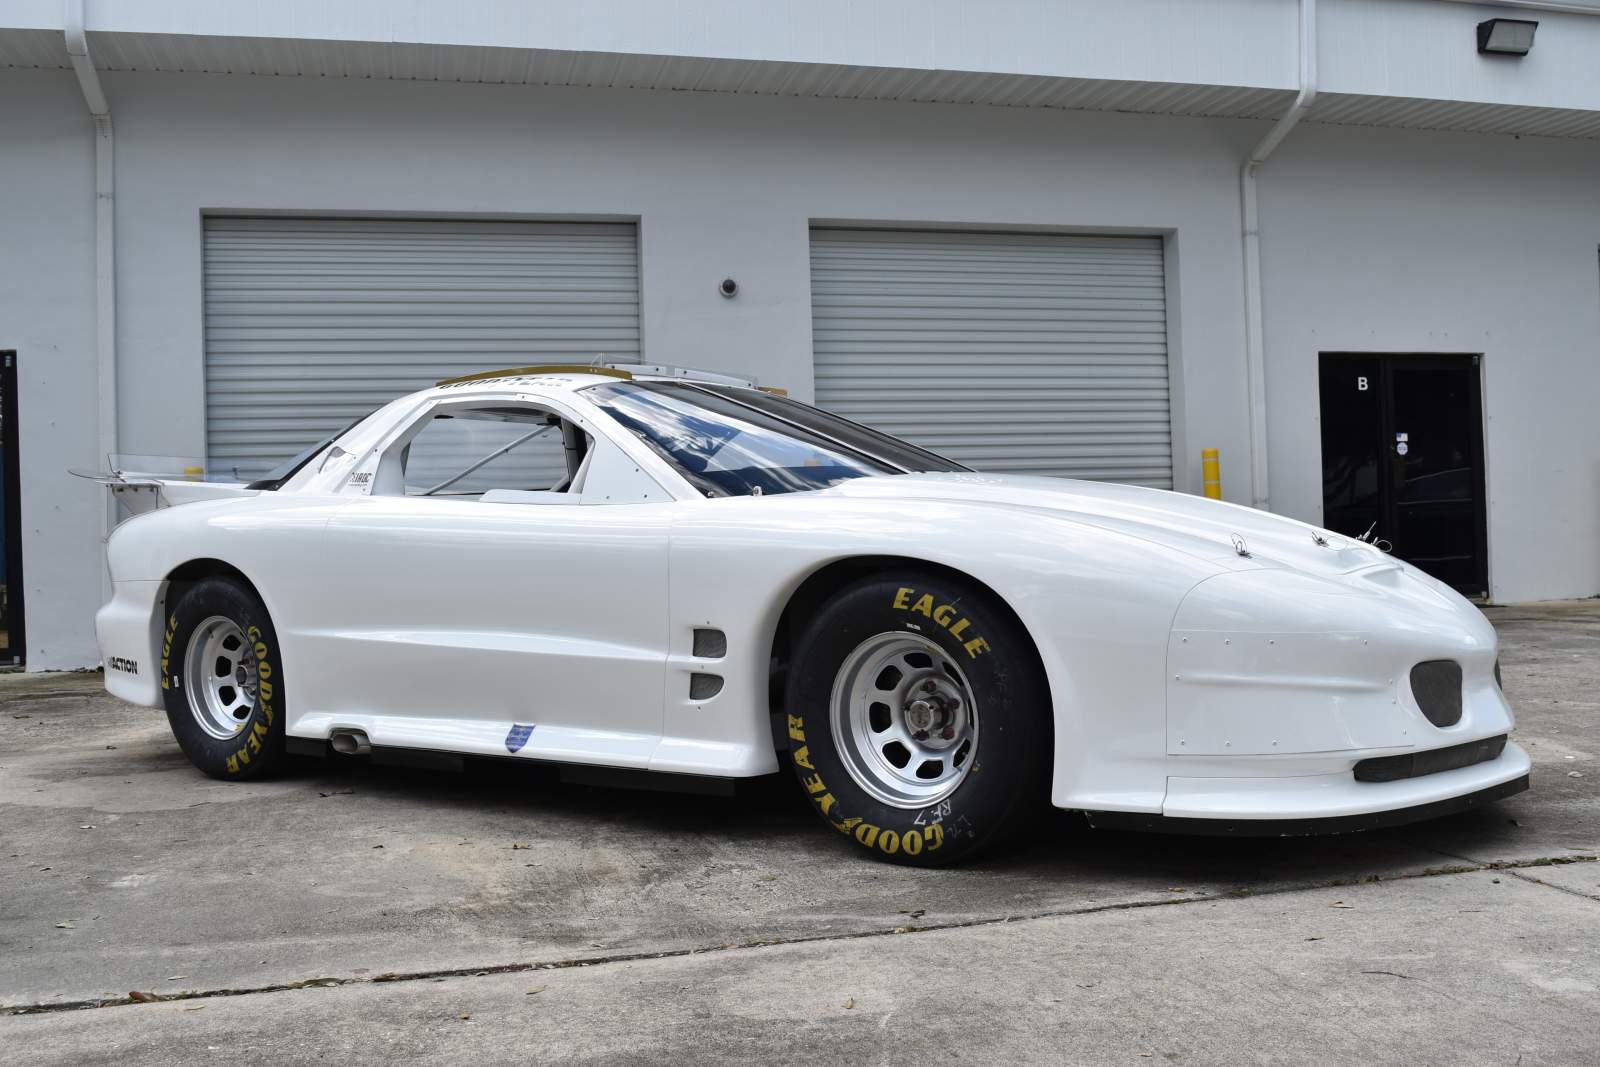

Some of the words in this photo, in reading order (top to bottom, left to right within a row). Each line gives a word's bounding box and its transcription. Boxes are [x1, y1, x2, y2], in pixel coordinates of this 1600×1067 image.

[1357, 376, 1368, 390] B
[160, 613, 179, 690] EAGLE
[892, 587, 992, 659] EAGLE
[787, 713, 944, 856] GOODYEAR
